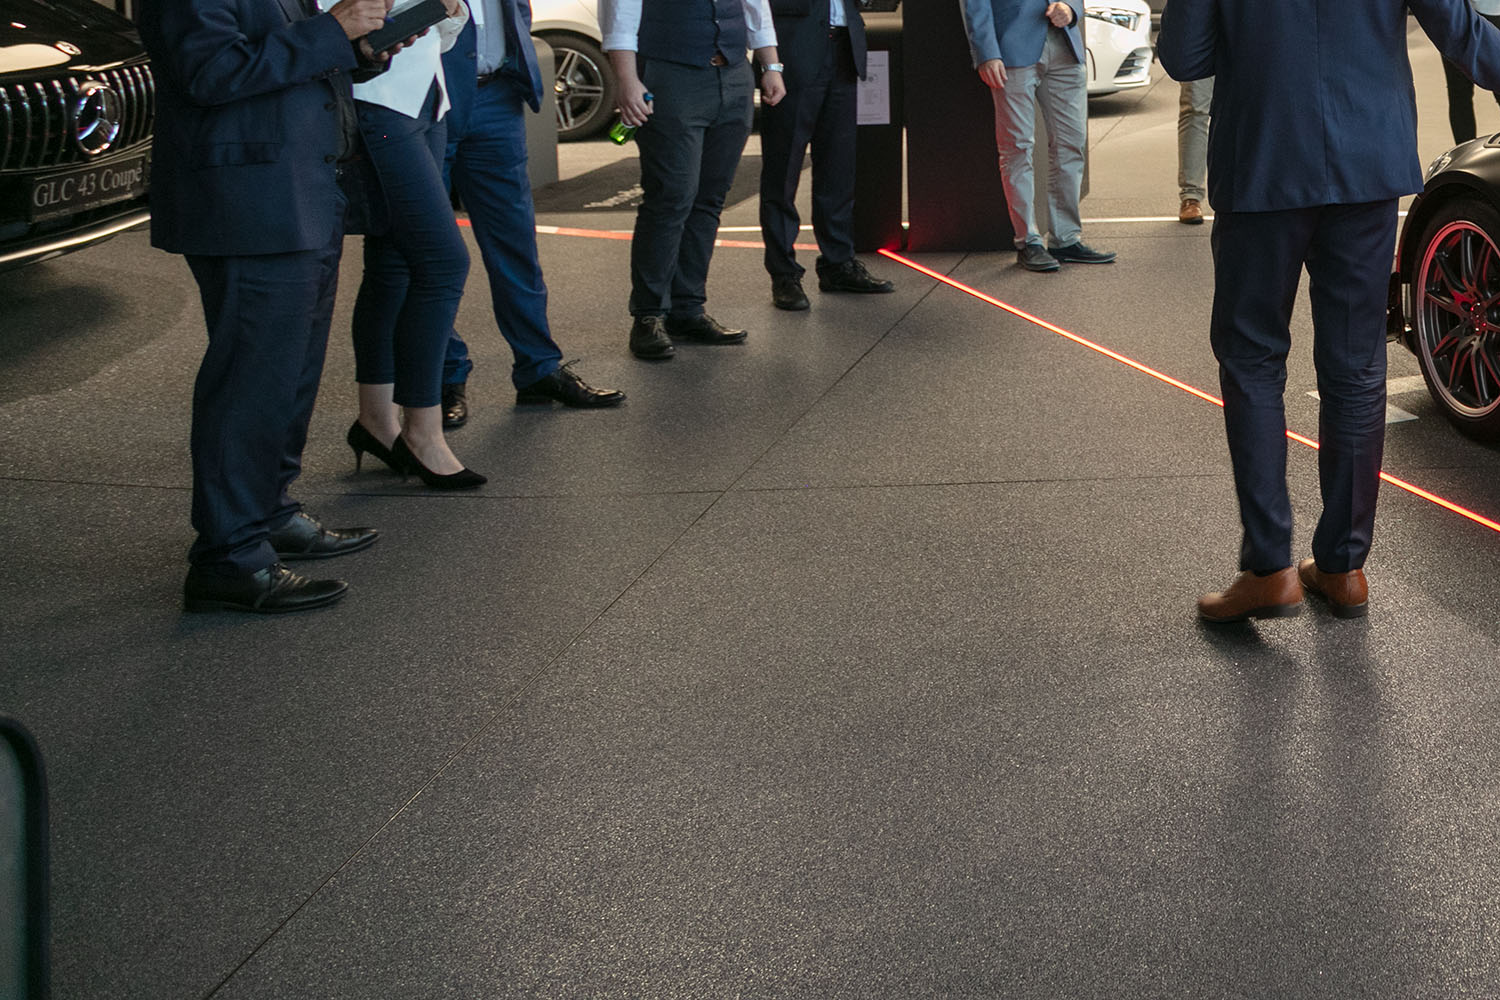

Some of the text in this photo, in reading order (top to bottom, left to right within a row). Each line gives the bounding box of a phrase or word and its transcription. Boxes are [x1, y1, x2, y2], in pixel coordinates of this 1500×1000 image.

[34, 161, 143, 207] GLC 43 Coupé
